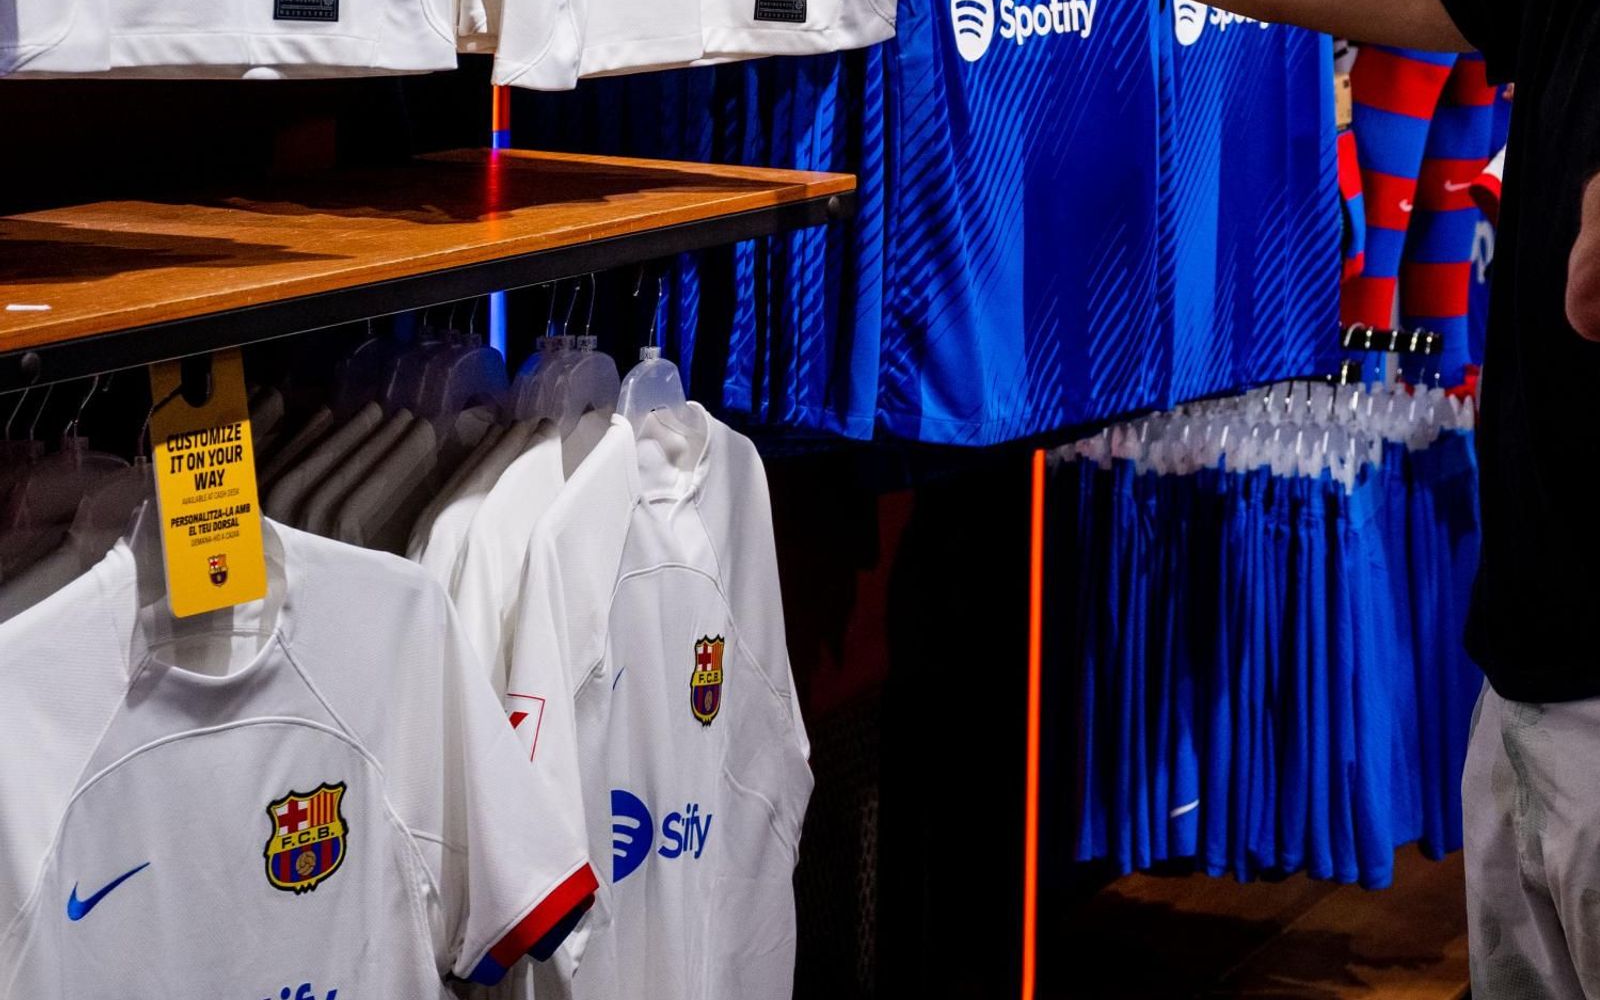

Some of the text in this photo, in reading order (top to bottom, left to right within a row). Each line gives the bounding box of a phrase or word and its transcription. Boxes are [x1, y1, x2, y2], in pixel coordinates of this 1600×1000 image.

[166, 423, 242, 453] CUSTOMIZE
[170, 444, 243, 475] IT ON YOUR
[194, 468, 226, 492] WAY
[171, 503, 251, 528] PERSONALITZA-LA AMB
[188, 517, 239, 537] EL TEU DORSAL
[282, 826, 335, 849] F.C.B.
